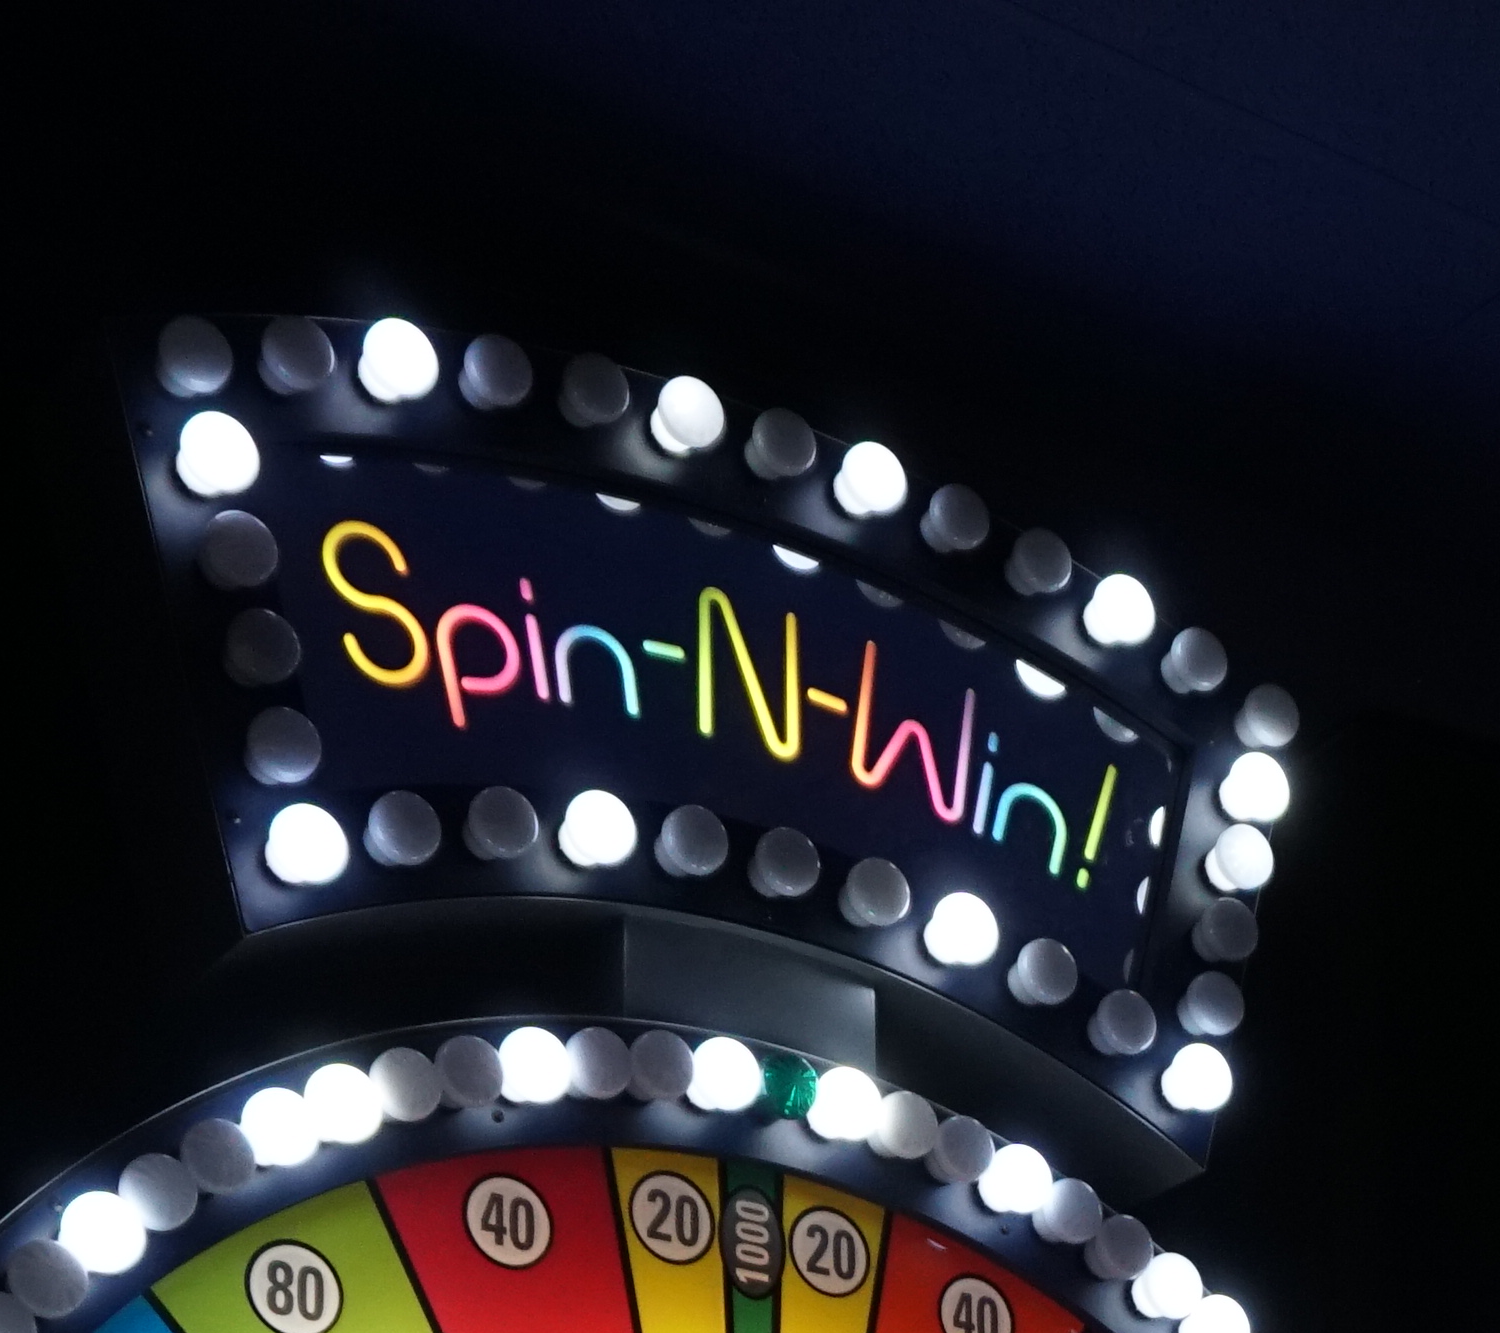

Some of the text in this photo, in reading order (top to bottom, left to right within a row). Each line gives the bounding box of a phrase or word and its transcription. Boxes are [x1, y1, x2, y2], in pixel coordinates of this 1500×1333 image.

[323, 520, 1118, 889] Spin-N-Win!
[481, 1193, 535, 1250] 40
[647, 1189, 699, 1247] 20
[735, 1200, 770, 1283] 1000
[807, 1225, 856, 1280] 20
[267, 1260, 324, 1320] 80
